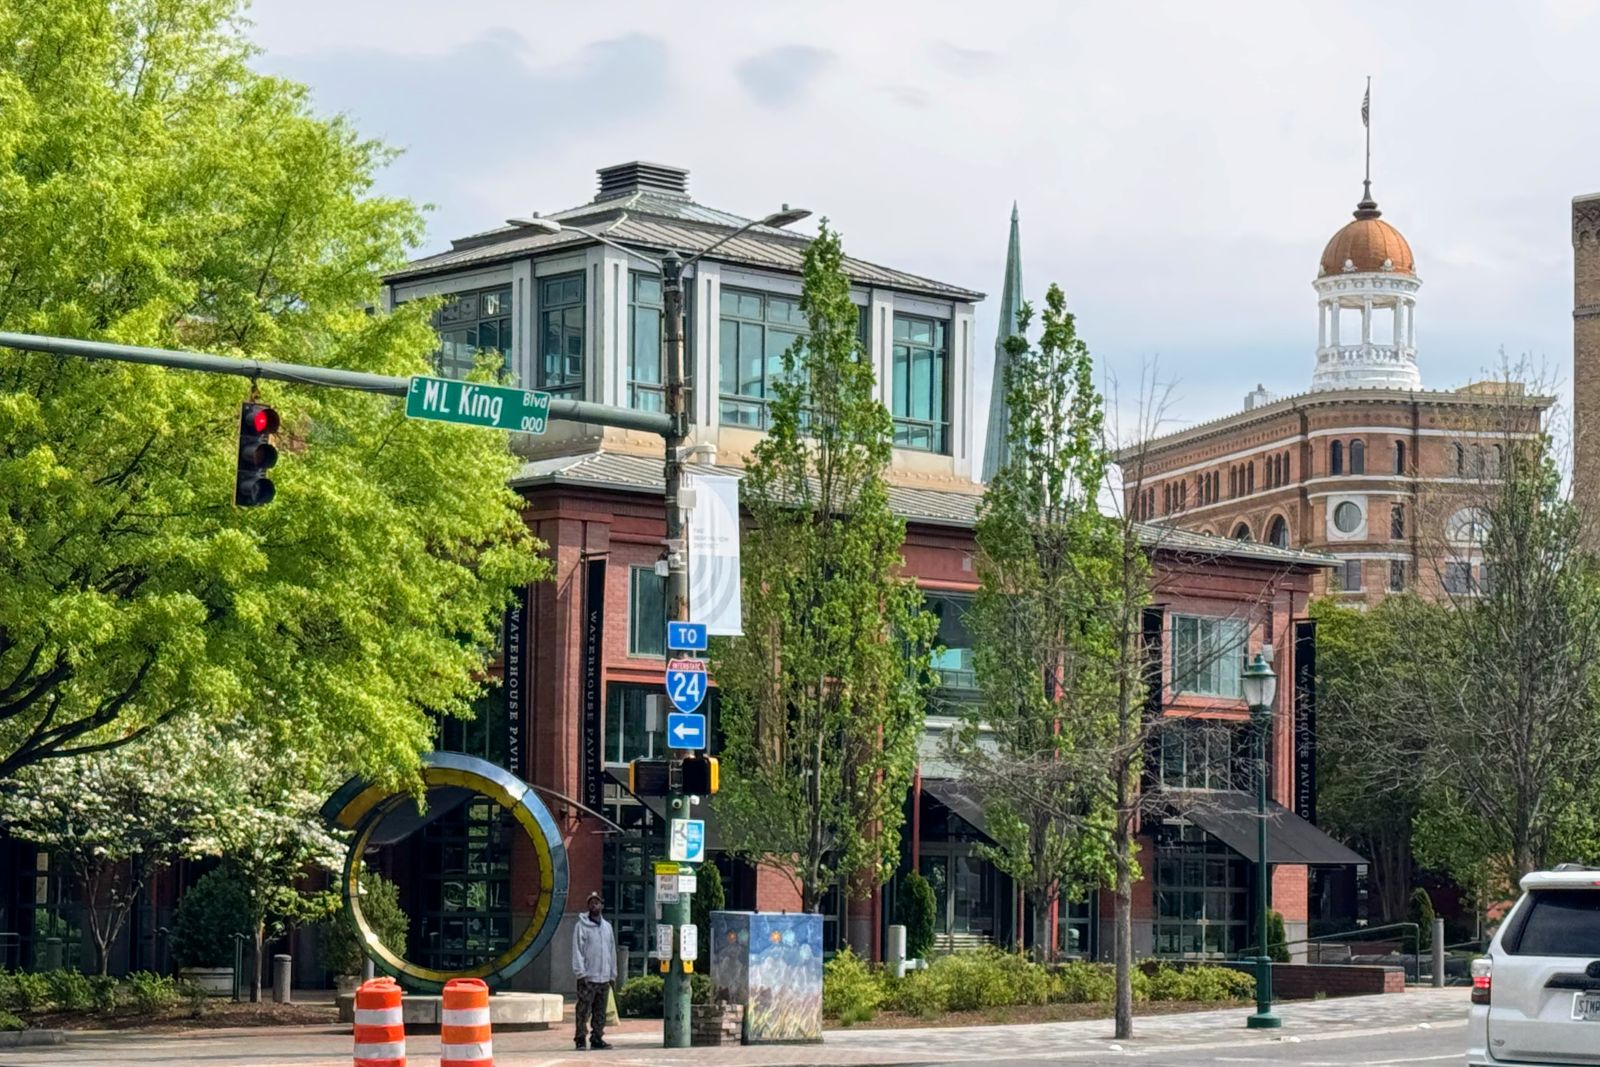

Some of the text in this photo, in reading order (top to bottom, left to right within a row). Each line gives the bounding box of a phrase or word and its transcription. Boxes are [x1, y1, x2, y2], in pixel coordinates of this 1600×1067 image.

[411, 378, 548, 426] E ML King Blvd
[521, 416, 543, 432] 000
[678, 628, 697, 644] TO
[509, 608, 520, 721] WATERHOUSE
[671, 662, 701, 671] INTERSTATE
[673, 672, 700, 703] 24
[585, 610, 598, 805] WATERHOUSE PAVILION
[1300, 763, 1310, 821] PAVILIO
